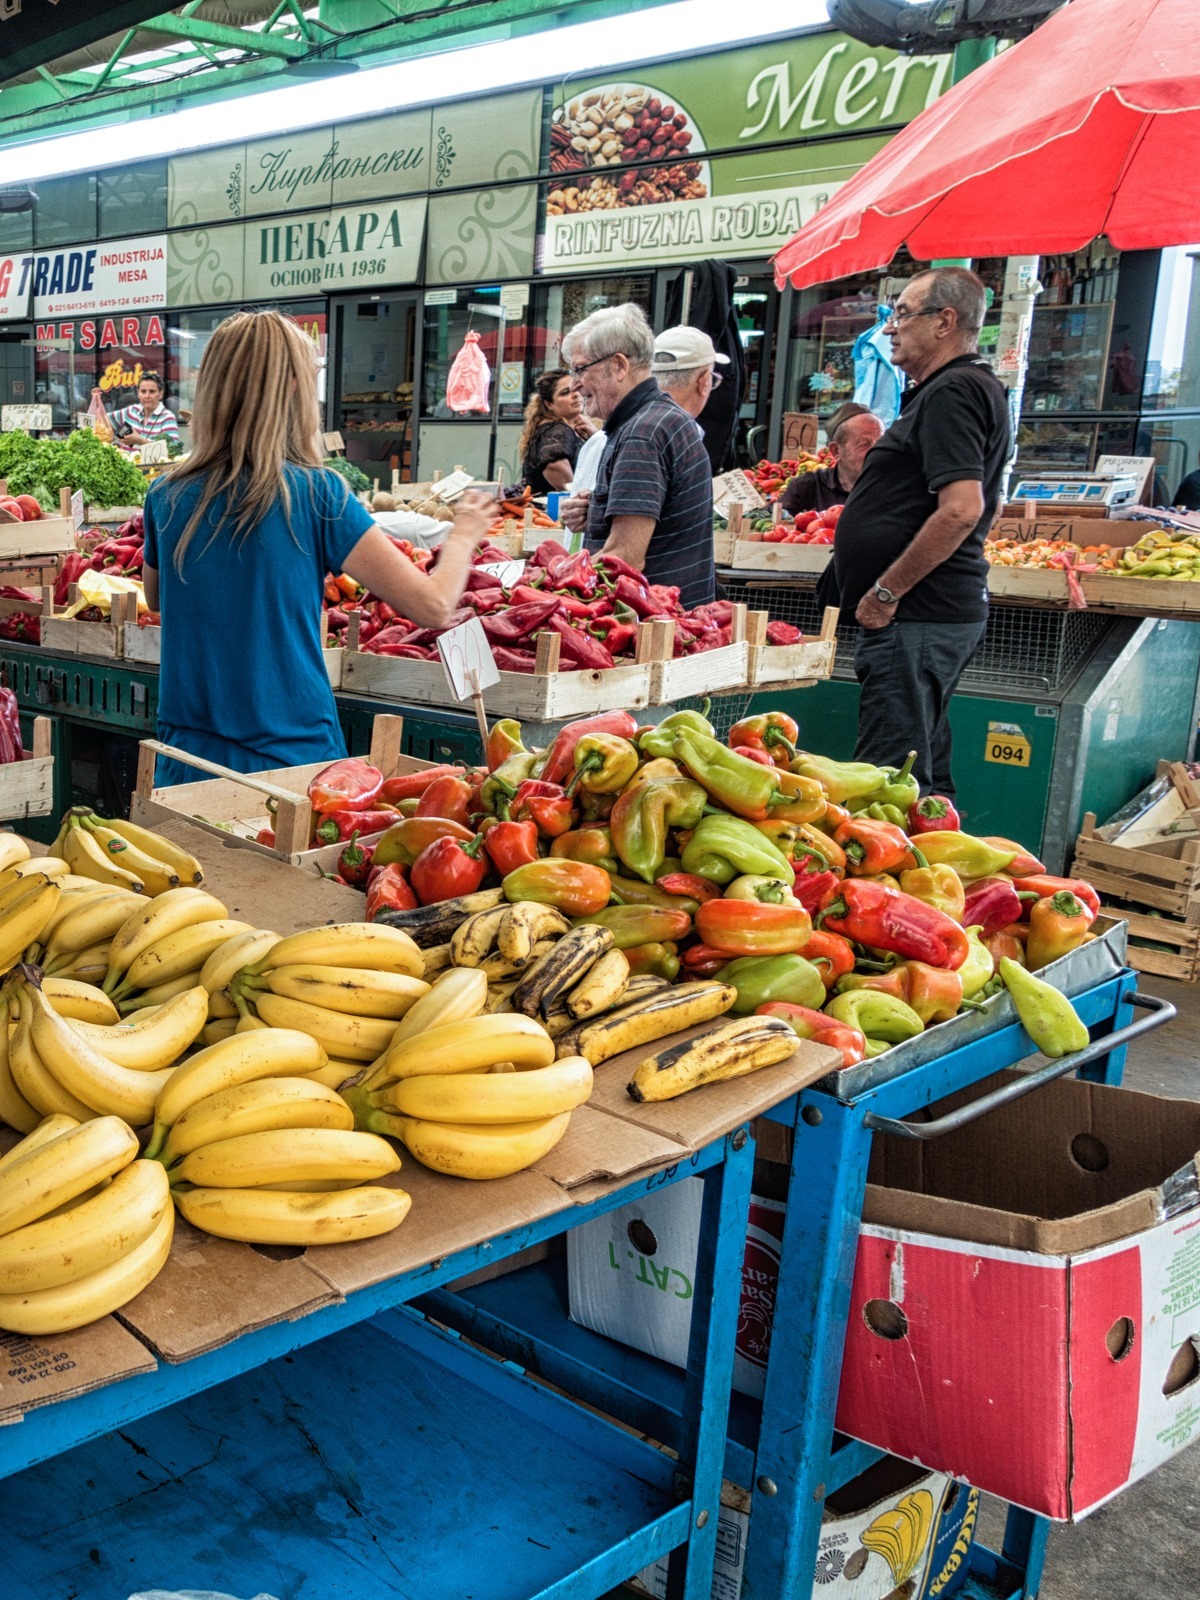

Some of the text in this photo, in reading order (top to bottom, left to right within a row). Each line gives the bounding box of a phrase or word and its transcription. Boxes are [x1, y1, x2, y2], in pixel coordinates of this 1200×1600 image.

[553, 207, 702, 257] RINFUZNA
[710, 194, 801, 242] ROBA
[259, 209, 403, 264] ПЕКАРА
[101, 248, 164, 267] INDUSTRIJA
[17, 250, 97, 298] TRADE
[118, 269, 148, 283] MESA
[351, 258, 387, 277] 1936
[36, 315, 166, 353] MESARA
[786, 420, 815, 452] 60
[991, 744, 1024, 762] 094
[627, 1250, 693, 1300] CAT.
[51, 1360, 77, 1373] COD.
[18, 1373, 38, 1384] 951
[818, 1536, 849, 1552] ecuado
